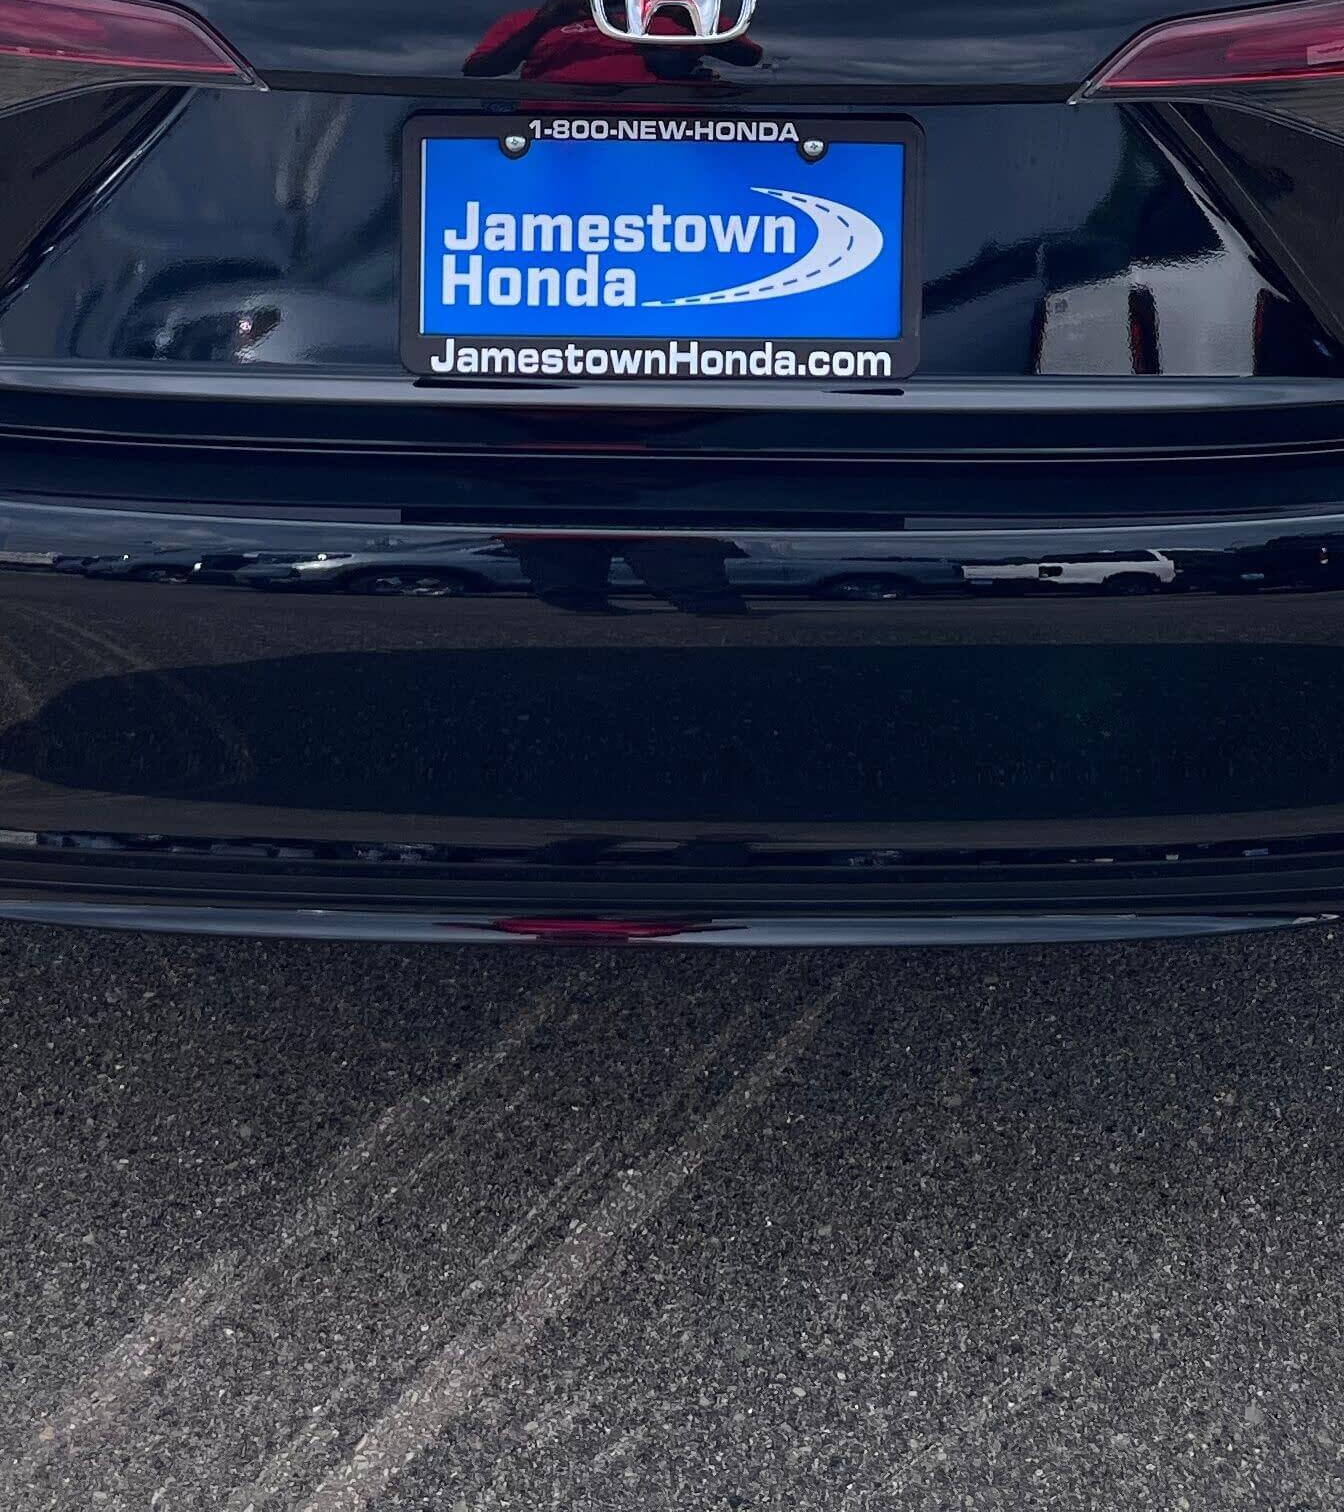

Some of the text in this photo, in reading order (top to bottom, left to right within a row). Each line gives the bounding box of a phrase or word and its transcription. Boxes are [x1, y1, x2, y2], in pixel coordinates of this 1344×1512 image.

[528, 119, 800, 142] 1-800-NEW-HONDA
[443, 200, 796, 254] Jamestown
[442, 254, 636, 307] Honda
[430, 338, 892, 377] JamestownHonda.com
